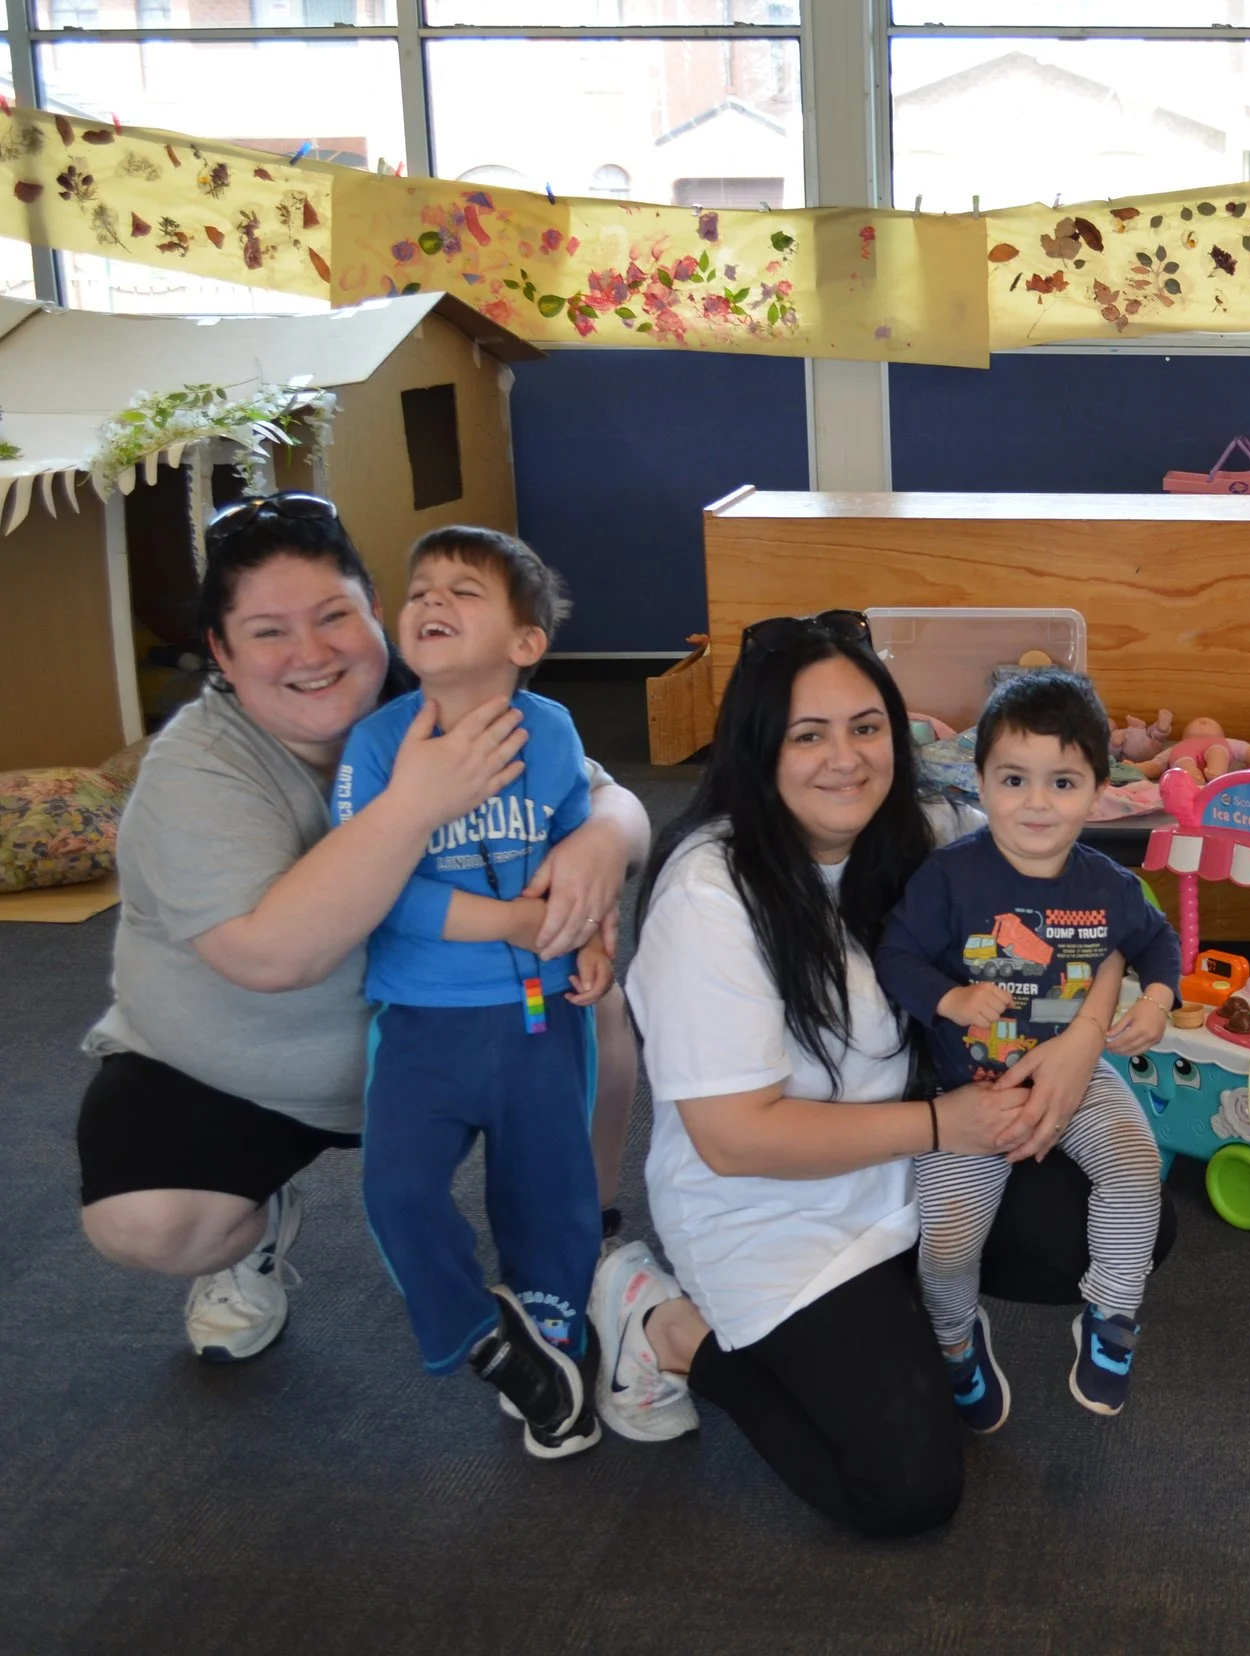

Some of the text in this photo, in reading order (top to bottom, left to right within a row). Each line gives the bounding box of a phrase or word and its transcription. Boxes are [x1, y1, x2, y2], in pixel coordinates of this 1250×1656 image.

[337, 764, 354, 799] CLUB
[427, 795, 555, 854] ONSDAL
[1212, 807, 1230, 821] Ice
[1046, 926, 1075, 939] DUMP
